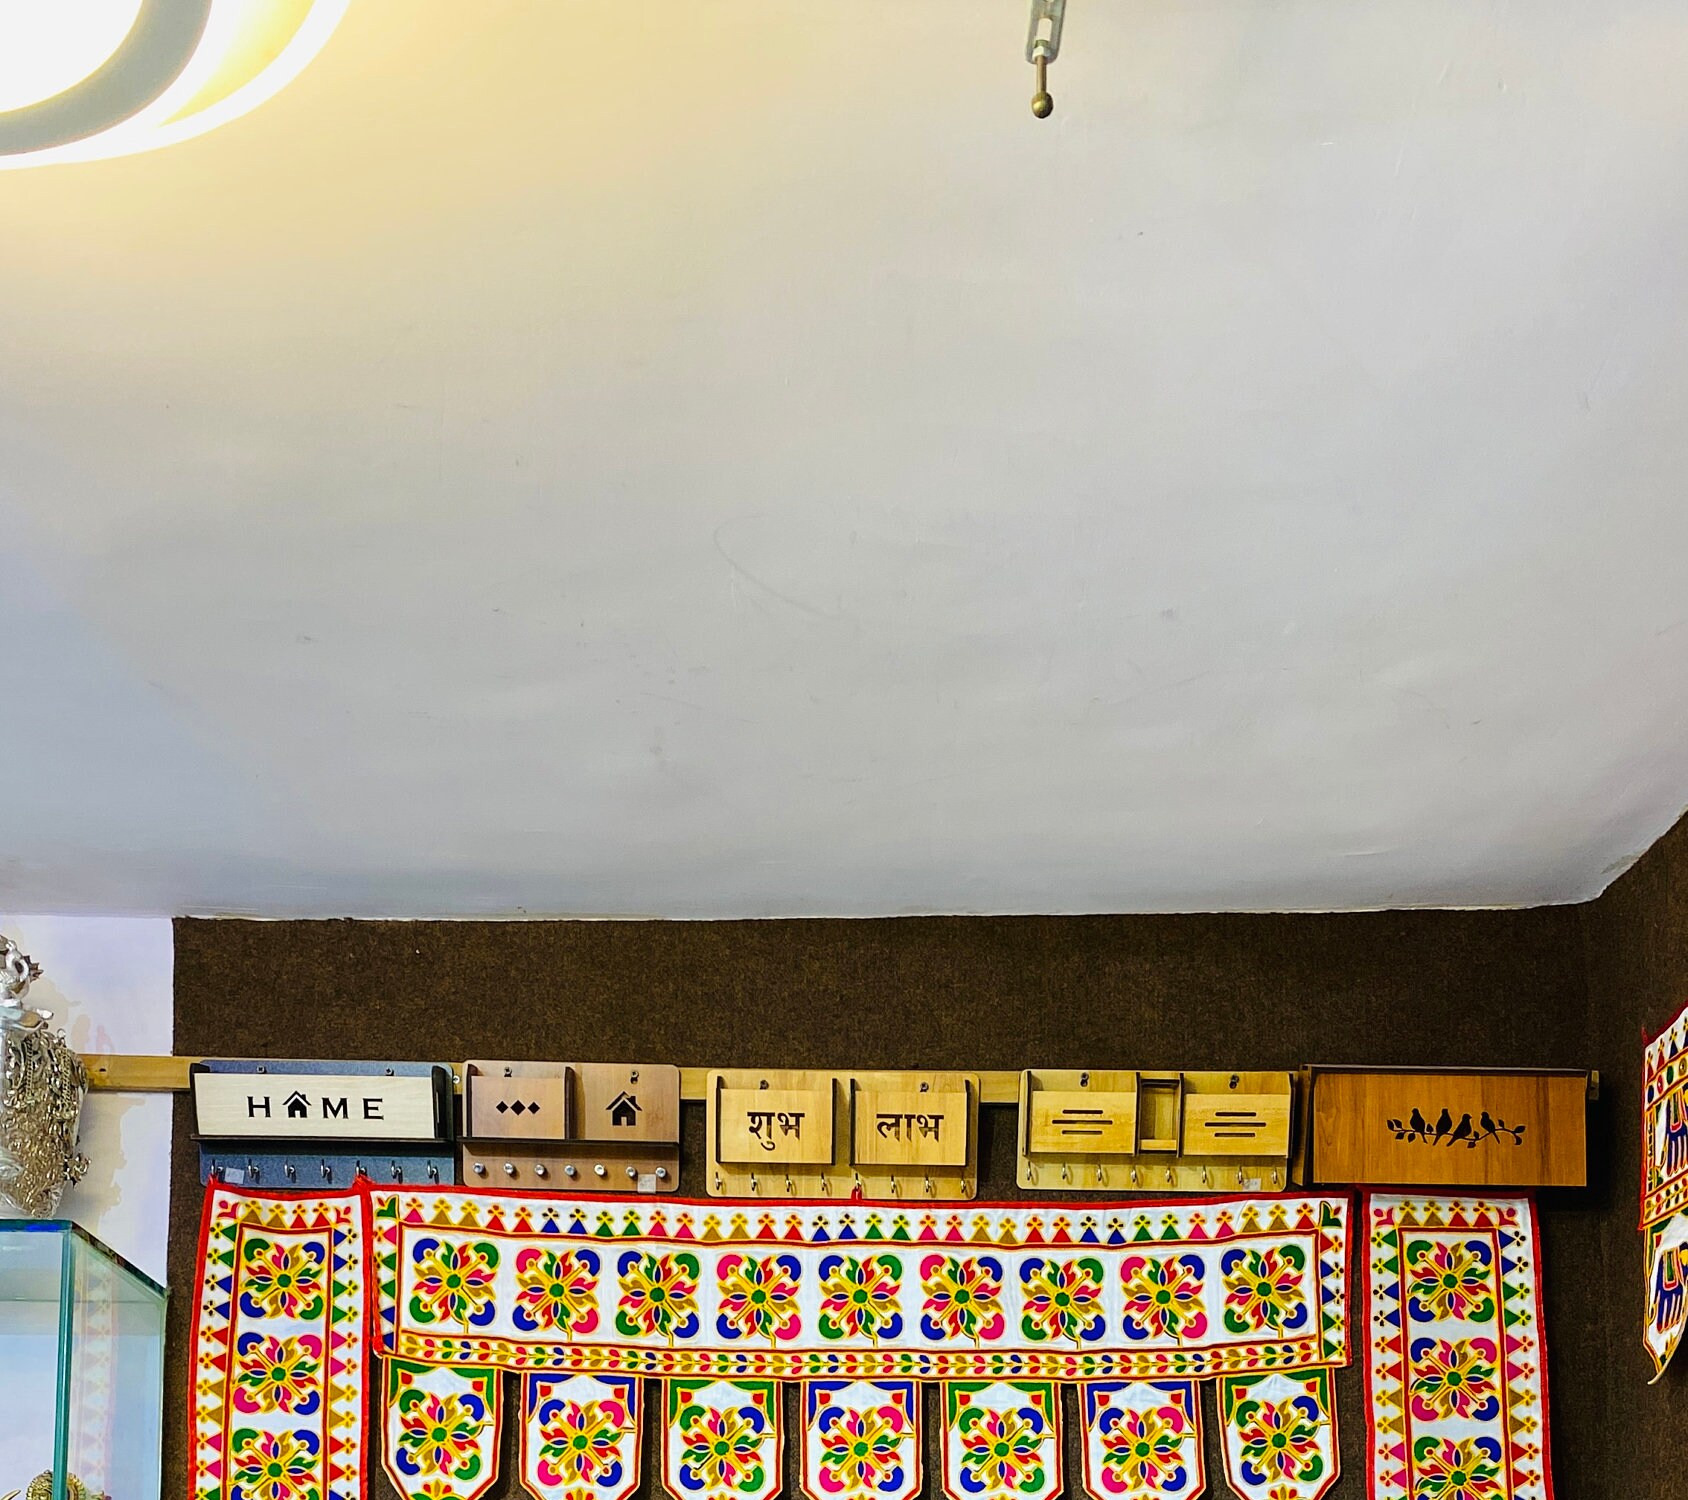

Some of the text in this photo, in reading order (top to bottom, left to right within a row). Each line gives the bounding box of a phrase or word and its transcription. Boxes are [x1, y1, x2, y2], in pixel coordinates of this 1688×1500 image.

[247, 1090, 385, 1120] HME
[747, 1111, 944, 1150] शुभ लाभ
